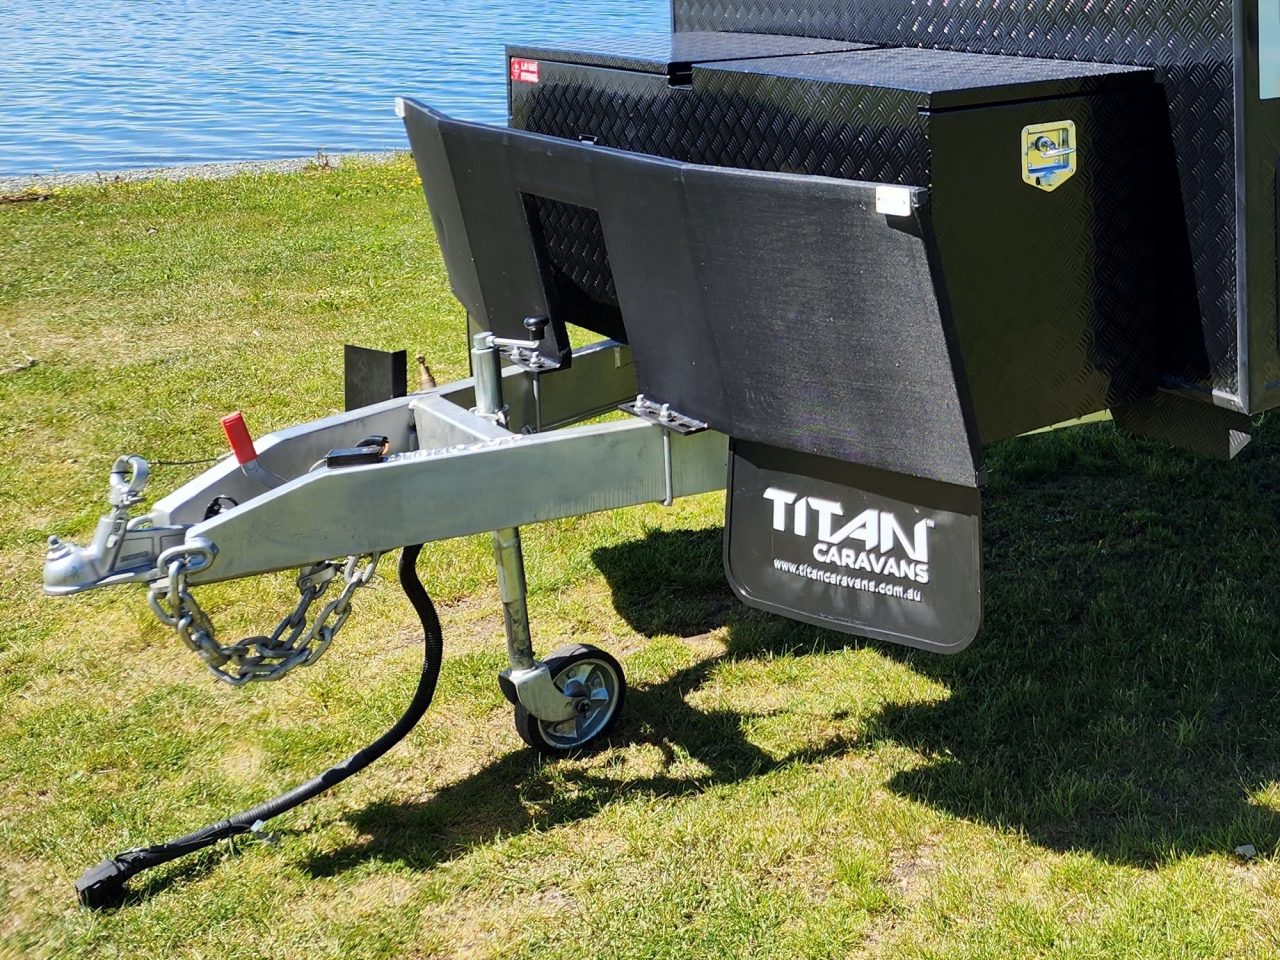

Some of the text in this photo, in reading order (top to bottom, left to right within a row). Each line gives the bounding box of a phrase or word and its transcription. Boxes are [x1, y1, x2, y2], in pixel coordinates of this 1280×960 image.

[763, 487, 929, 563] TITAN
[773, 558, 922, 602] www.titancaravans.com.au
[812, 543, 930, 584] CARAVANS
